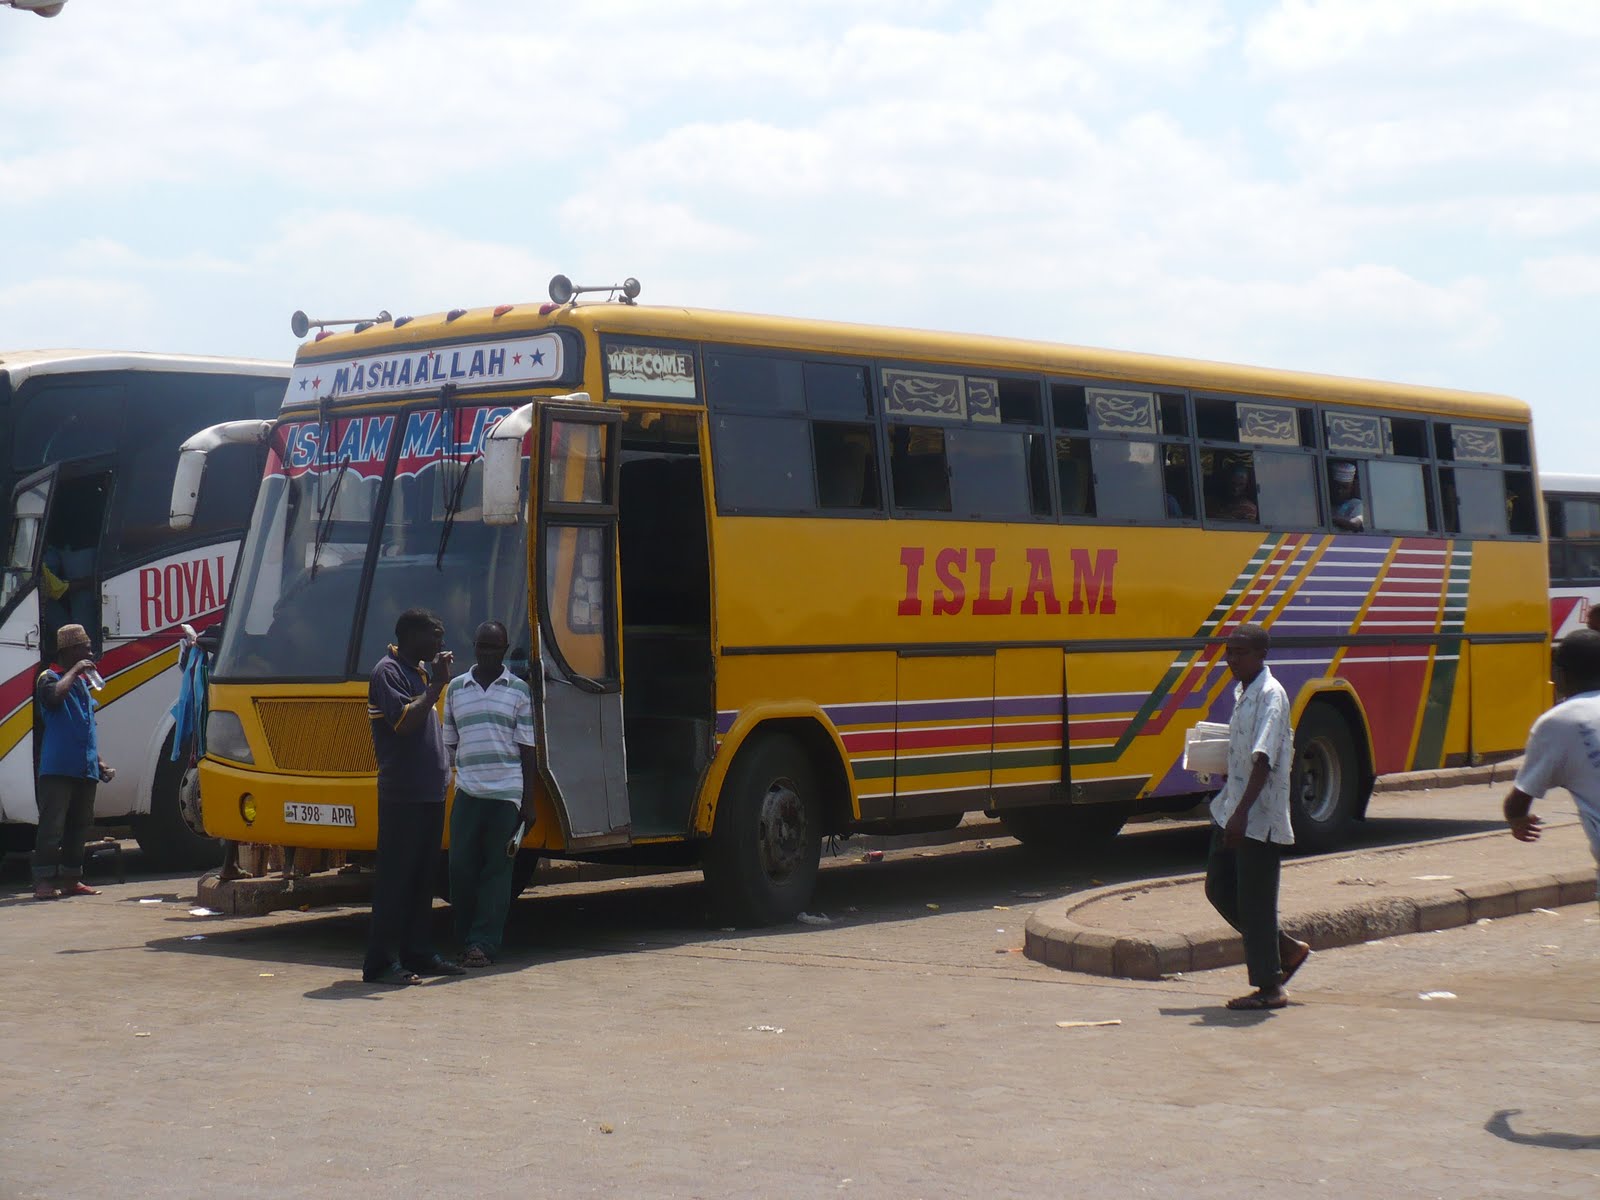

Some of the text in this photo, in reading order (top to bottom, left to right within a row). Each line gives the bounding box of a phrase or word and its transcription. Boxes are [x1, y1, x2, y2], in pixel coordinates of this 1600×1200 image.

[608, 353, 686, 375] WELCOME
[281, 416, 395, 469] ISLAM
[139, 555, 227, 632] ROYAL
[897, 547, 1118, 616] ISLAM
[292, 805, 352, 824] T 398 APR
